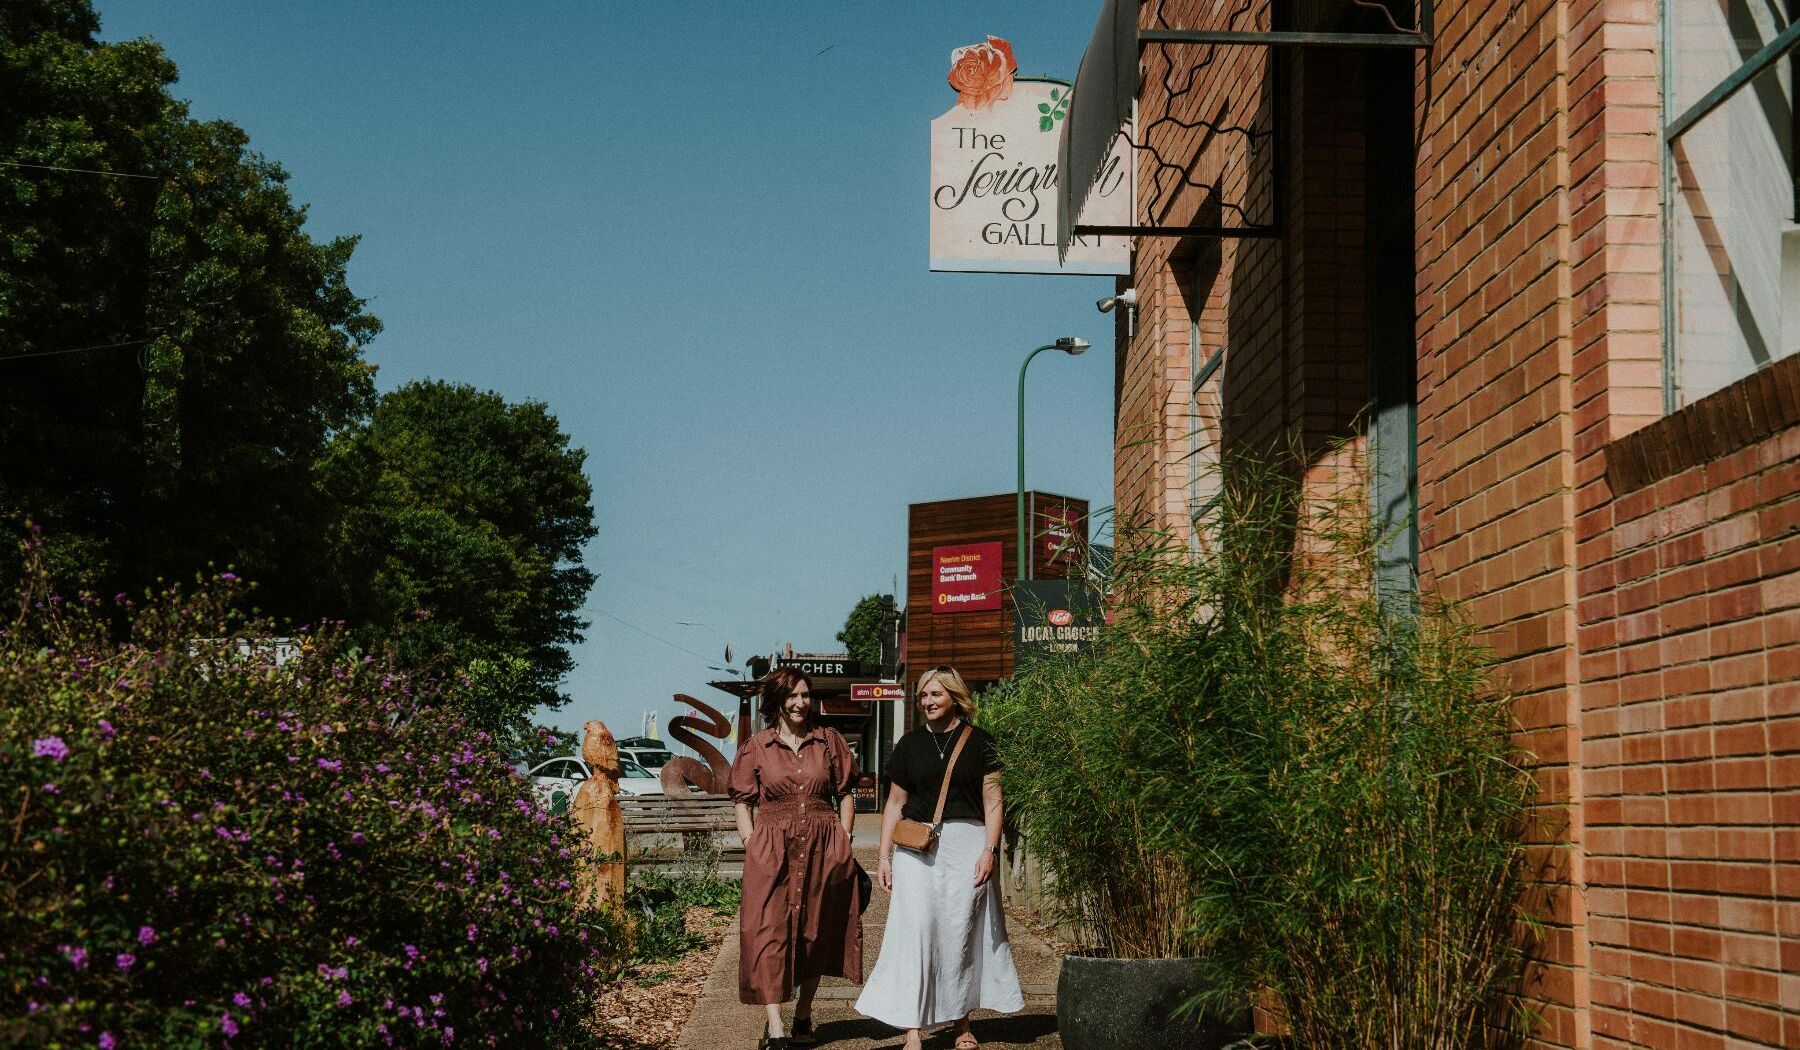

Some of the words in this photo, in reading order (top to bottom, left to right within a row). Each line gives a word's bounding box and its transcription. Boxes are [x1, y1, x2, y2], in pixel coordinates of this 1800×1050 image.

[952, 127, 1006, 149] The
[961, 553, 981, 562] District
[940, 564, 973, 574] Community
[956, 573, 977, 581] Branch
[947, 593, 970, 603] Bendigo
[970, 592, 986, 601] Bank
[1021, 626, 1056, 643] LOCAL
